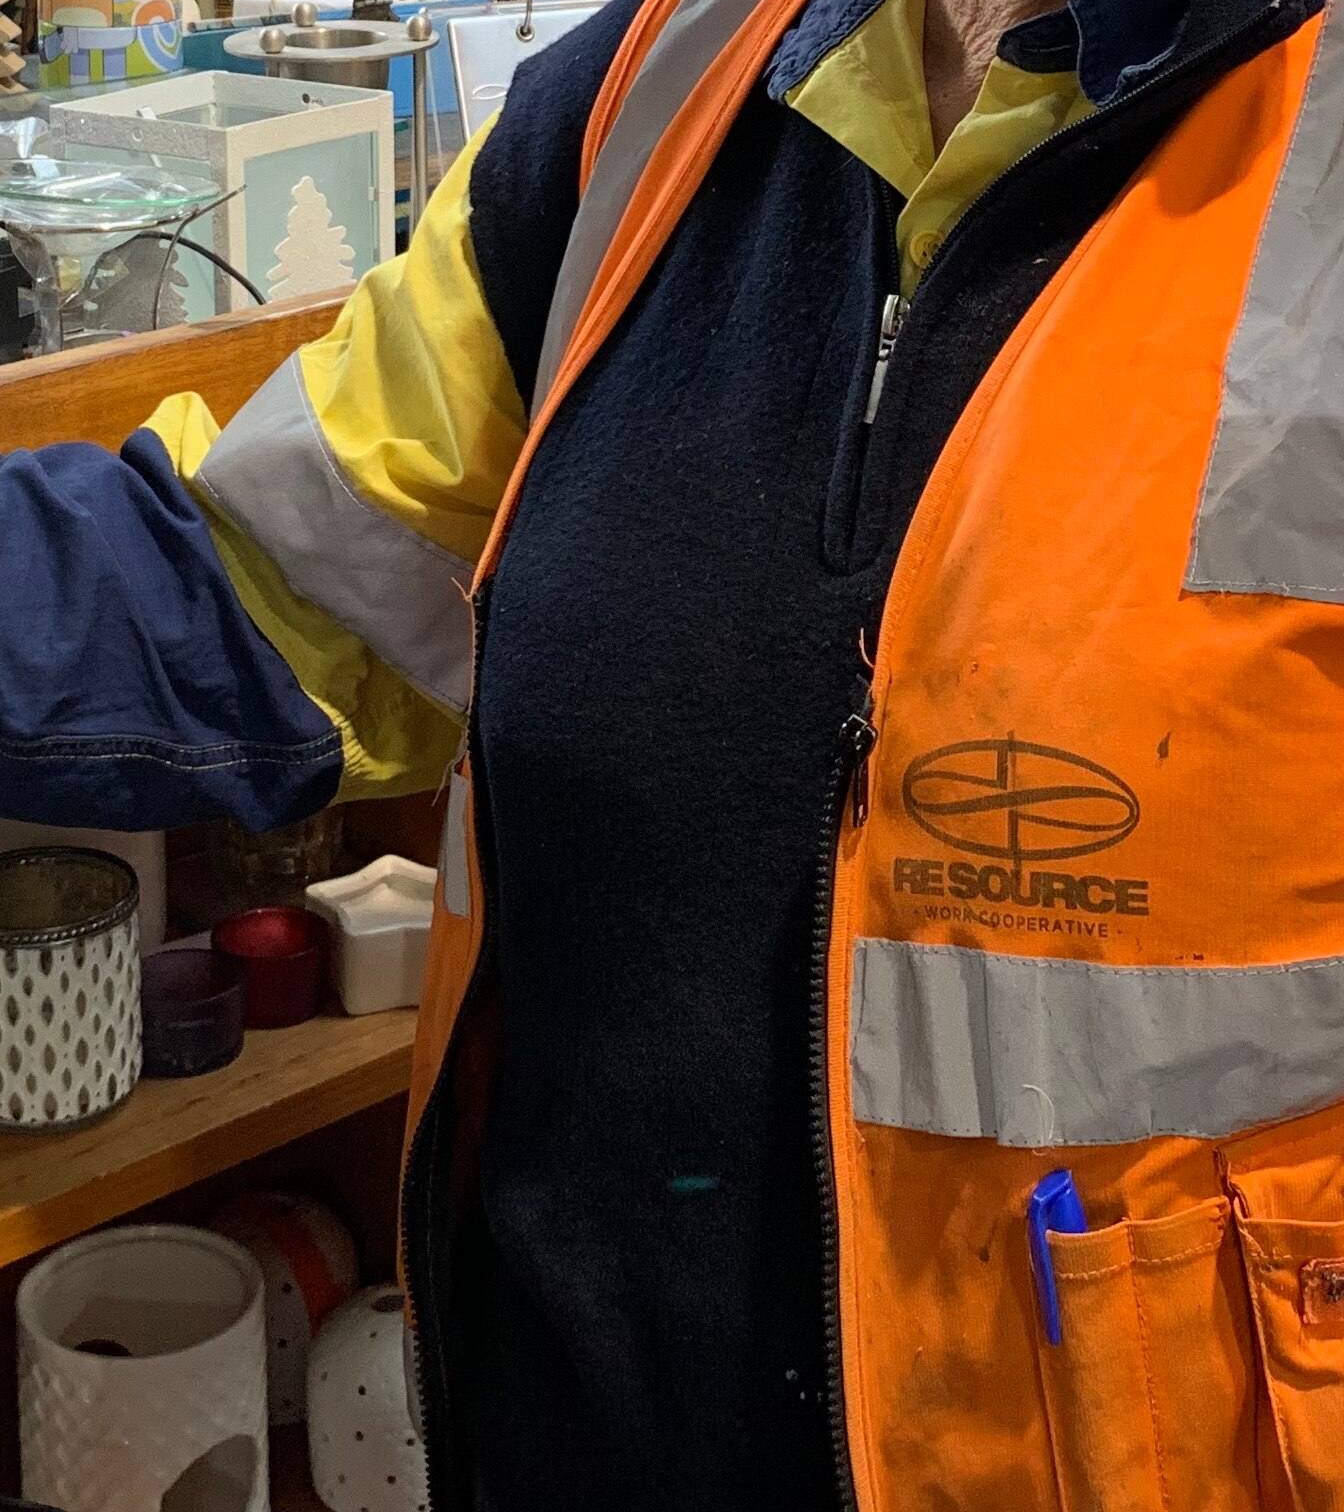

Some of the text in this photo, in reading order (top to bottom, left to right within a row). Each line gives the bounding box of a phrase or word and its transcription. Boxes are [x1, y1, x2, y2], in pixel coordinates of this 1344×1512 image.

[892, 856, 1150, 916] RESOURCE
[924, 904, 1109, 939] WORK COOPERATIVE
